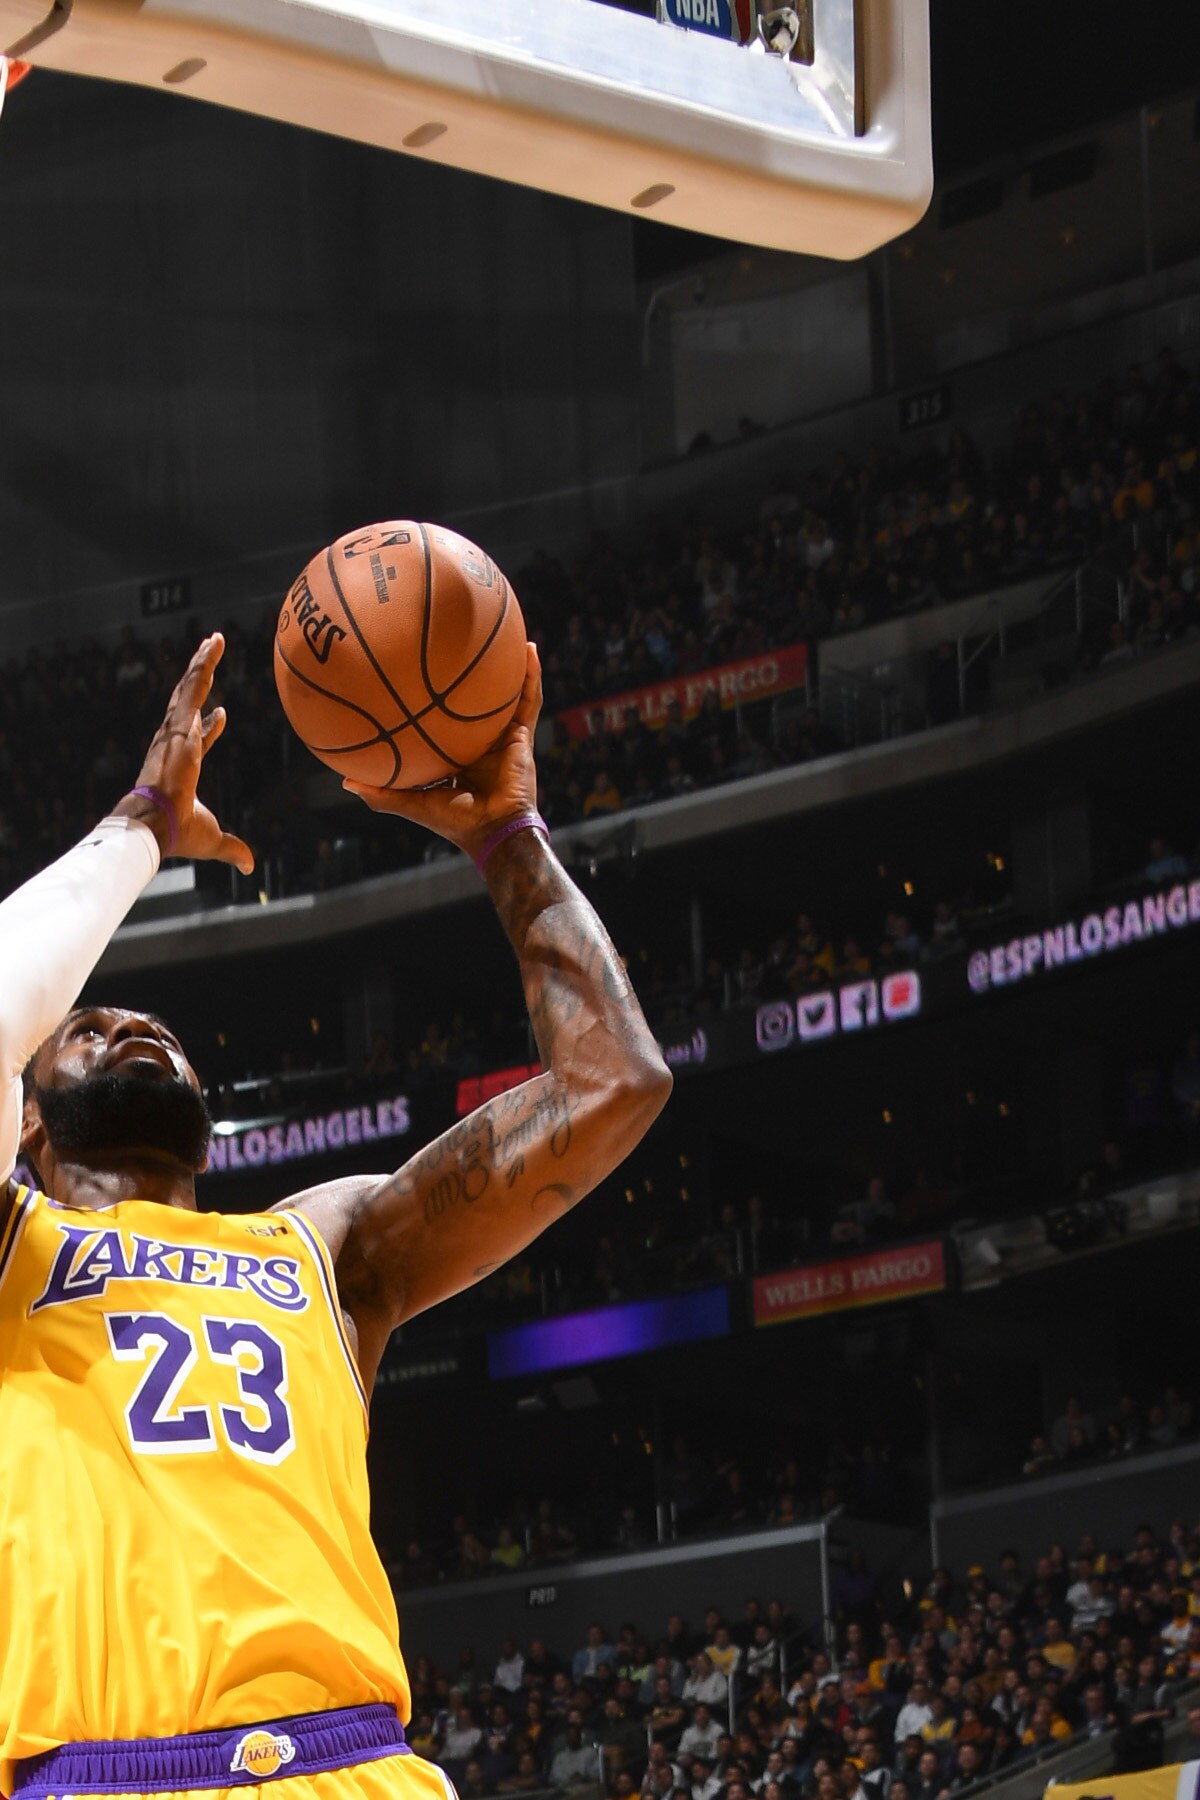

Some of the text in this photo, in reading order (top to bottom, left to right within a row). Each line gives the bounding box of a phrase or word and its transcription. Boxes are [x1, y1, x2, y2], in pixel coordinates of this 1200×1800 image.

[675, 0, 721, 28] NBA
[290, 573, 348, 664] SPALD
[967, 880, 1200, 993] @ESPNLOSANGE
[206, 1095, 410, 1172] NLOSANGELES
[246, 1224, 288, 1238] ish
[27, 1223, 310, 1318] LAKERS
[765, 1256, 932, 1307] WELLS FARGO
[103, 1311, 297, 1467] 23
[231, 1742, 294, 1772] LAKERS
